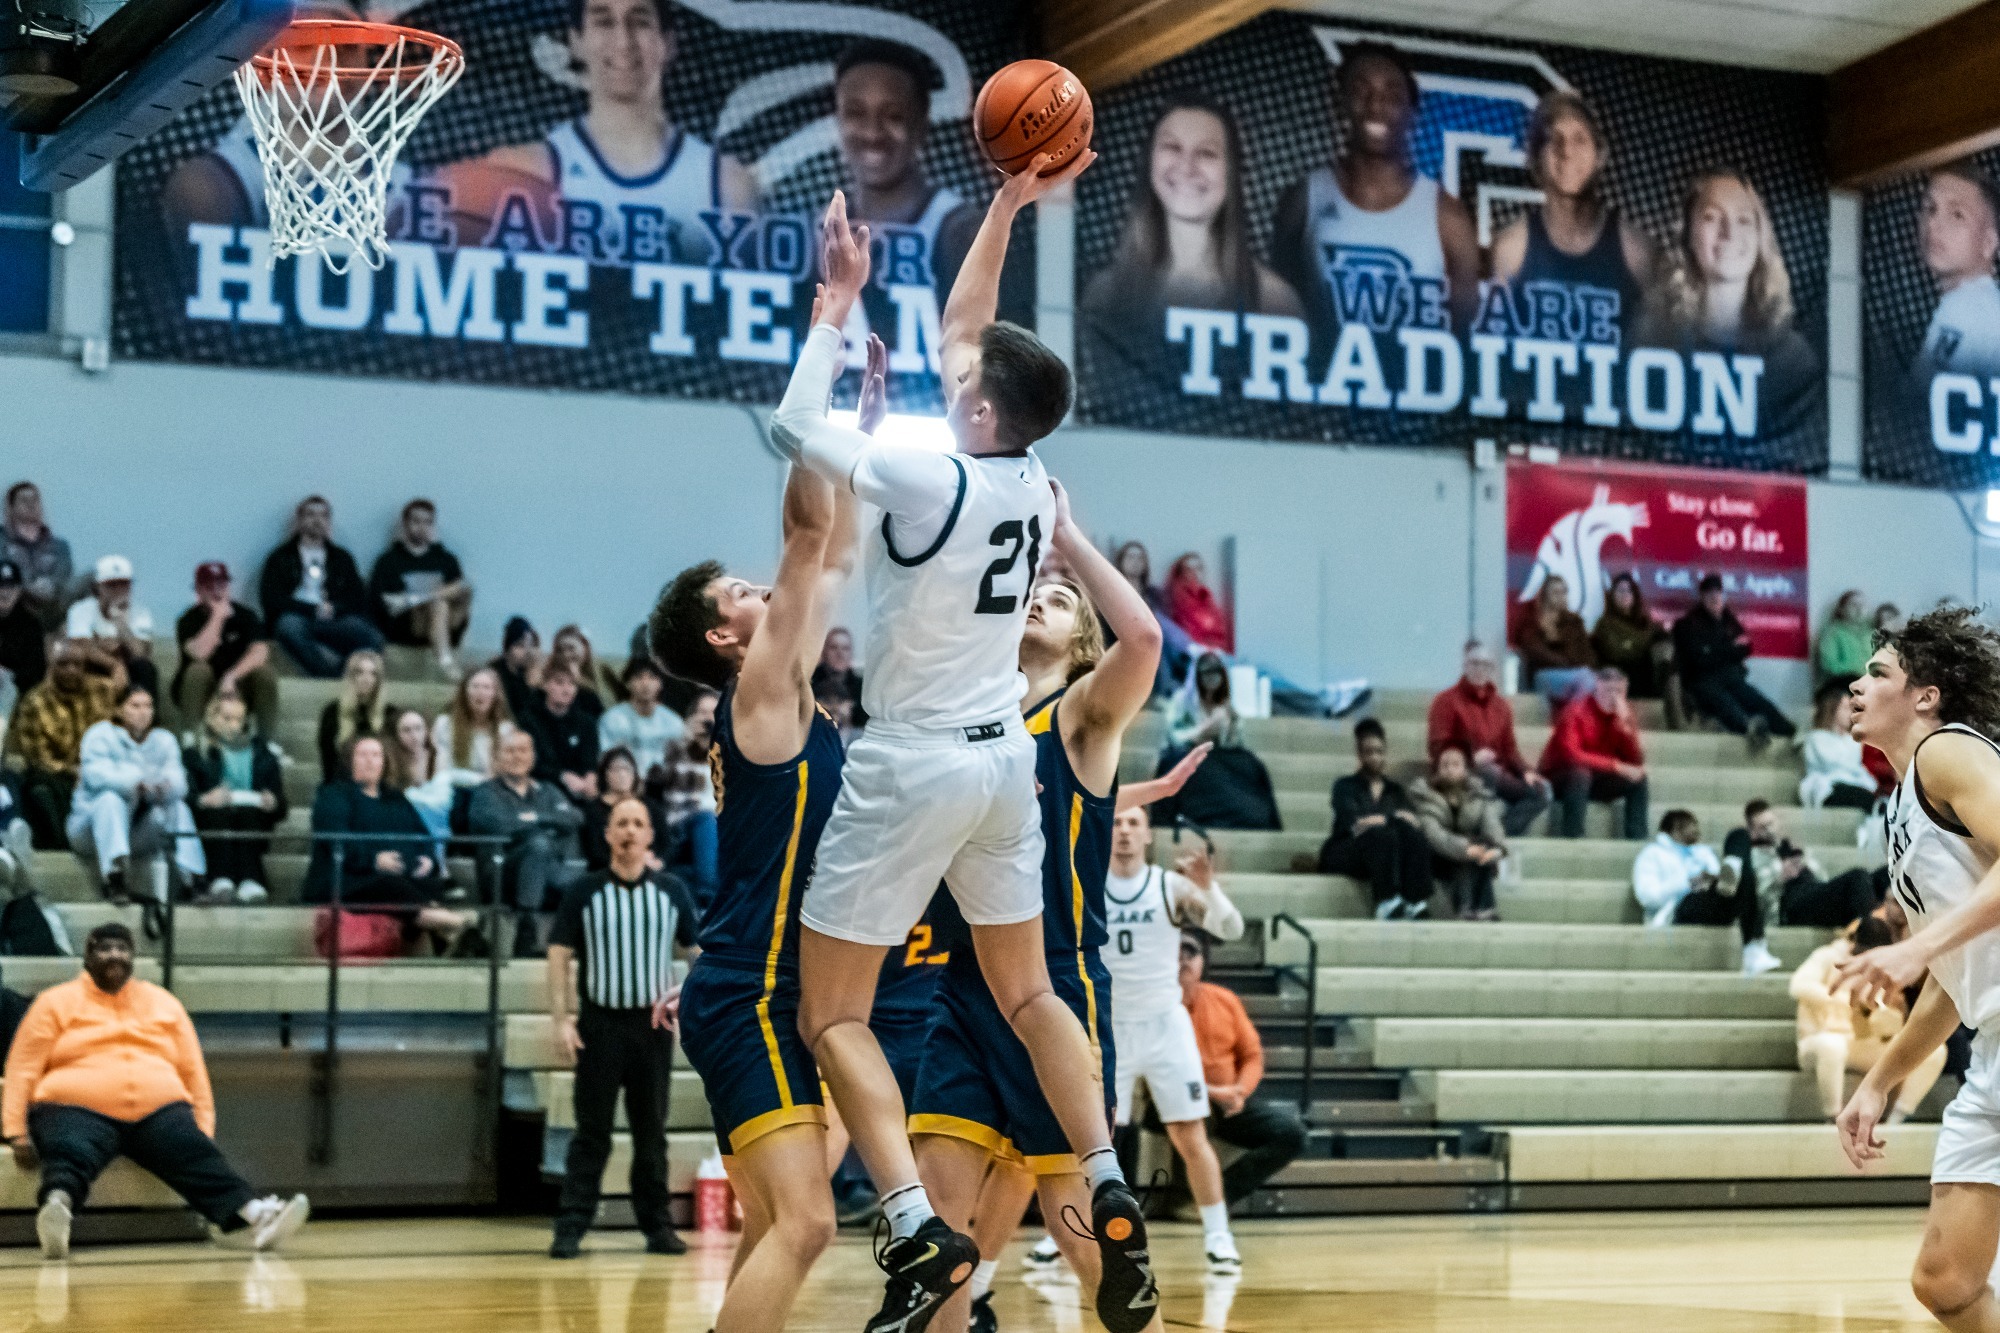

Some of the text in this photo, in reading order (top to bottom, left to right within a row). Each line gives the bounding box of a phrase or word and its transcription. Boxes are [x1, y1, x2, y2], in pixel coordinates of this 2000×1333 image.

[481, 189, 670, 265] ARE
[698, 205, 937, 288] YOR
[186, 222, 589, 347] HOME
[1327, 266, 1620, 346] WE ARE
[1166, 306, 1764, 438] TRADITION
[1929, 372, 2000, 457] C
[1696, 520, 1785, 553] Go far.
[1117, 928, 1134, 956] 0
